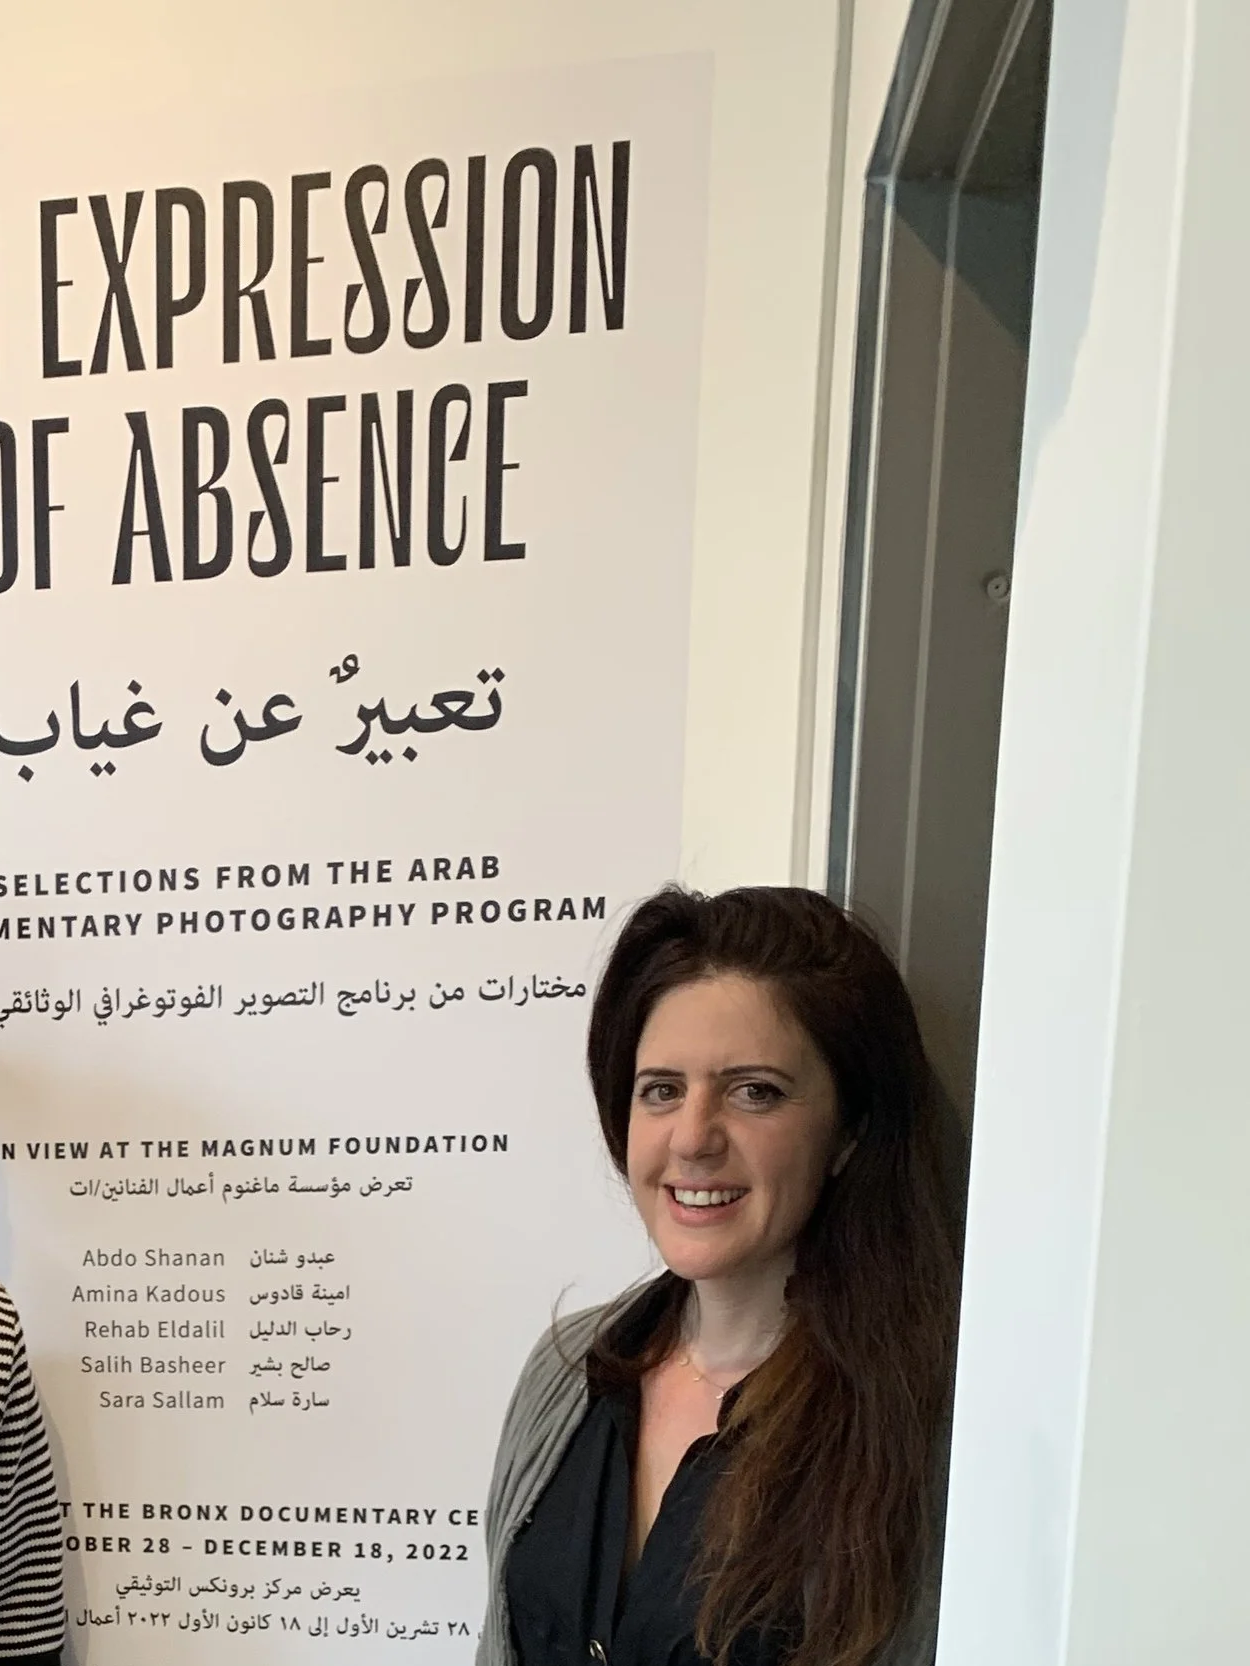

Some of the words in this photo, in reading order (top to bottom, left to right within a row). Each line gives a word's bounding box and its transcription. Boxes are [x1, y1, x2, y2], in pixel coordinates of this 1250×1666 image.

[40, 140, 630, 379] EXPRESSION
[112, 380, 528, 585] ABSENCE
[200, 688, 303, 766] عن
[217, 863, 309, 889] FROM
[327, 860, 392, 884] THE
[408, 856, 499, 881] ARAB
[157, 903, 415, 934] PHOTOGRAPHY
[432, 897, 605, 925] PROGRAM
[234, 982, 324, 1016] التصوير
[337, 979, 415, 1016] برنامج
[429, 983, 464, 1009] من
[479, 974, 586, 1005] مختارات
[94, 985, 222, 1026] الفوتوغرافي
[27, 1142, 88, 1159] VIEW
[99, 1142, 129, 1159] AT
[141, 1141, 189, 1158] THE
[202, 1138, 315, 1157] MAGNUM
[329, 1134, 507, 1155] FOUNDATION
[167, 1172, 213, 1197] أعمال
[222, 1177, 279, 1203] ماغنوم
[288, 1176, 351, 1198] مؤسسة
[360, 1177, 413, 1197] تعرض
[83, 1249, 137, 1267] Abdo
[145, 1248, 224, 1266] Shanan
[250, 1249, 288, 1268] شنان
[296, 1253, 334, 1269] عبدو
[72, 1285, 137, 1302] Amina
[147, 1284, 225, 1302] Kadous
[250, 1284, 303, 1305] قادوس
[86, 1320, 149, 1338] Rehab
[158, 1320, 224, 1338] Eldalil
[250, 1321, 296, 1341] الدليل
[305, 1321, 351, 1342] رحاب
[81, 1355, 132, 1373] Salih
[141, 1356, 226, 1374] Basheer
[249, 1357, 282, 1377] بشير
[291, 1356, 330, 1379] صالح
[100, 1391, 144, 1408] Sara
[153, 1391, 224, 1408] Sallam
[250, 1392, 285, 1414] سلام
[292, 1392, 329, 1411] سارة
[59, 1502, 72, 1518] T
[83, 1503, 129, 1519] THE
[143, 1504, 227, 1521] BRONX
[241, 1506, 437, 1525] DOCUMENTARY
[66, 1536, 131, 1552] OBER
[143, 1538, 169, 1553] 28
[205, 1539, 341, 1557] DECEMBER
[355, 1543, 393, 1563] 18,
[406, 1544, 468, 1560] 2022
[116, 1575, 180, 1599] التوثيقي
[189, 1577, 255, 1599] برونكس
[262, 1578, 301, 1600] مركز
[310, 1582, 360, 1602] يعرض
[76, 1605, 120, 1626] أعمال
[178, 1608, 219, 1632] الأول
[227, 1614, 272, 1634] كانون
[308, 1616, 328, 1637] إلى
[336, 1613, 378, 1637] الأول
[386, 1620, 439, 1640] تشرين
